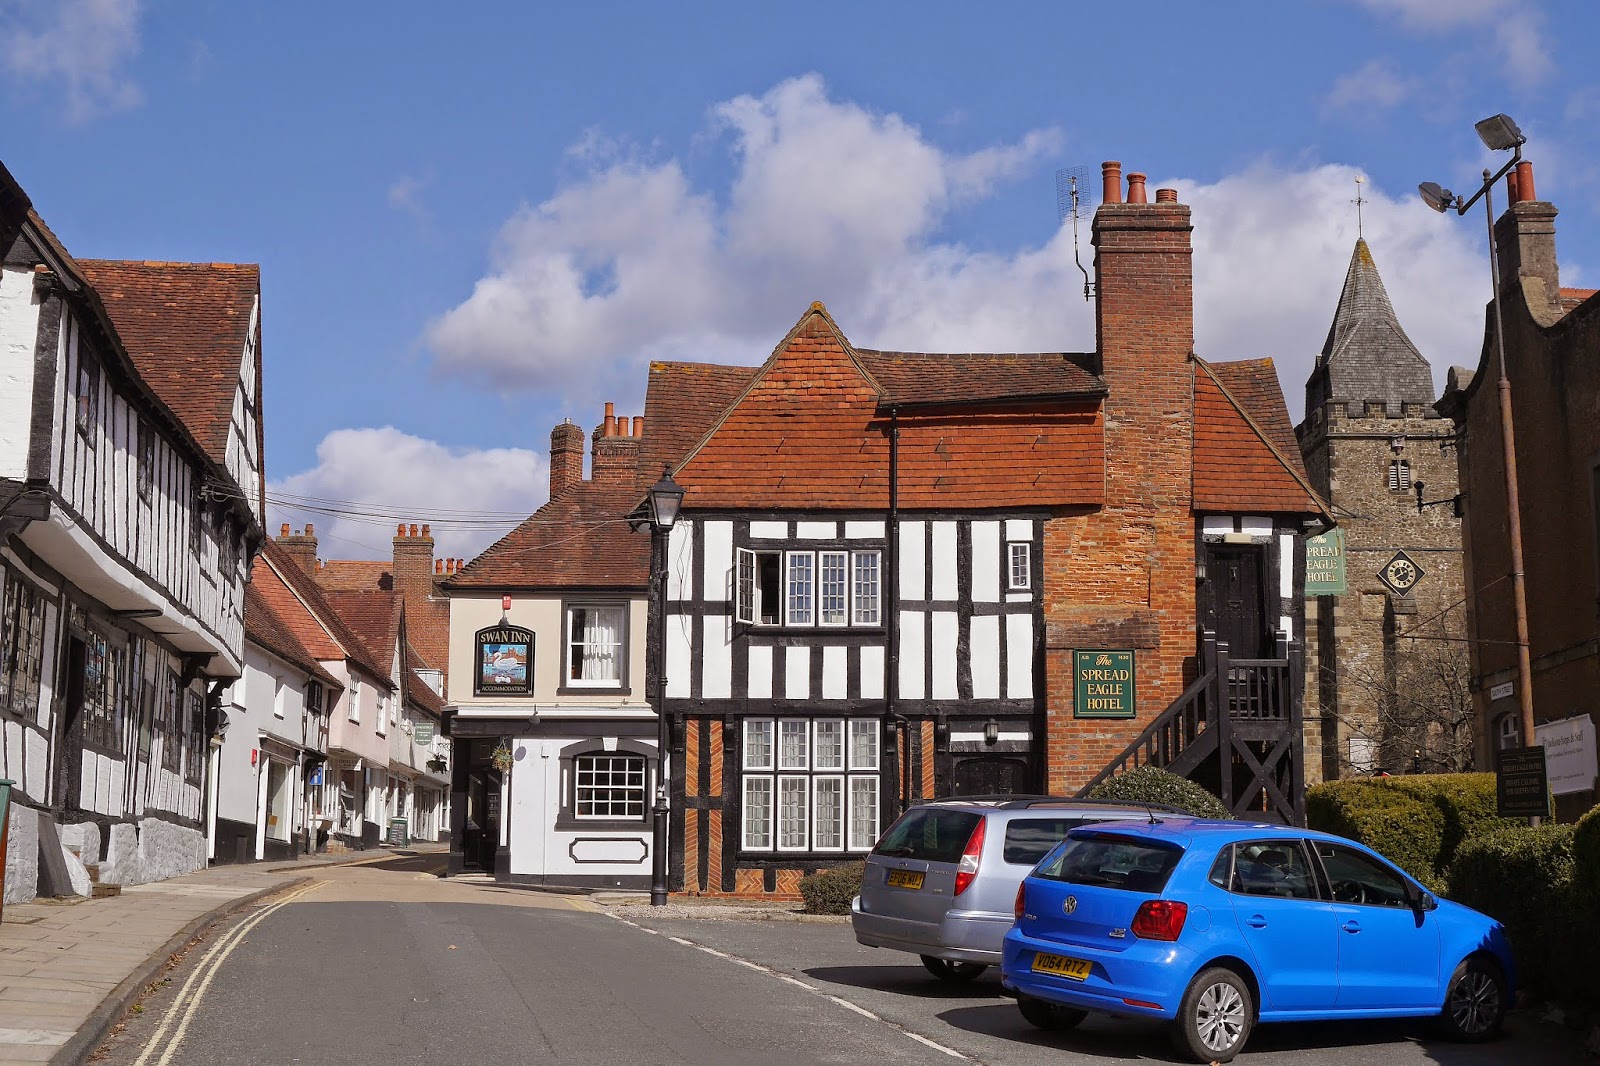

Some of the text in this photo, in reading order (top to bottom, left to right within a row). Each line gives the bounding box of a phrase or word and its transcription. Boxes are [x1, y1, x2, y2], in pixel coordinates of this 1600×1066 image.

[1312, 535, 1327, 544] The
[1306, 547, 1341, 557] PREAD
[1306, 559, 1338, 570] EAGLE
[1306, 572, 1339, 583] HOTEL
[480, 631, 530, 643] SWAN INN
[1096, 654, 1113, 666] The
[1081, 669, 1129, 681] SPREAD
[1087, 684, 1124, 695] EAGLE
[1087, 698, 1124, 710] HOTEL
[1063, 959, 1087, 974] RTZ
